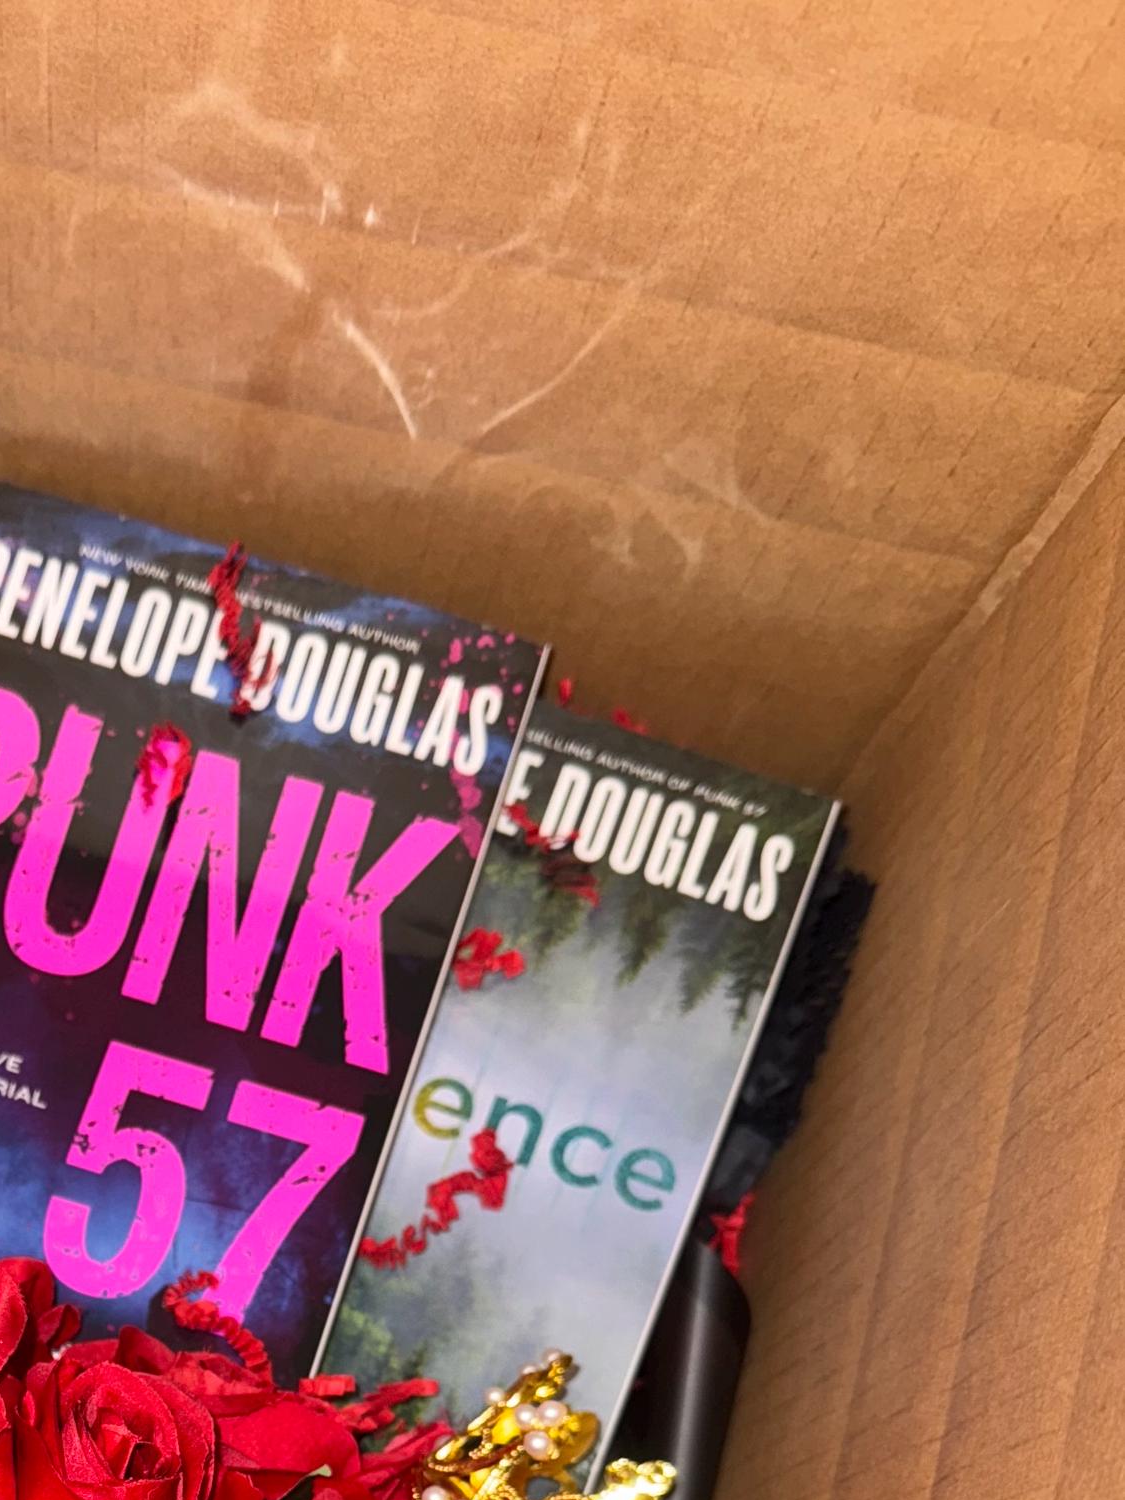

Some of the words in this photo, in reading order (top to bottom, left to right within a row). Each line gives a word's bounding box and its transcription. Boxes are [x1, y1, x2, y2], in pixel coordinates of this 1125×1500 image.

[79, 543, 124, 567] NEW
[126, 556, 170, 583] YORK
[347, 622, 421, 655] AUTHOR
[240, 619, 503, 776] DOUGLAS
[538, 762, 795, 923] DOUGLAS
[596, 751, 667, 785] AUTHOR
[667, 771, 695, 792] OF
[693, 783, 742, 811] PUNK
[43, 1040, 366, 1335] 57
[413, 1076, 676, 1212] ence
